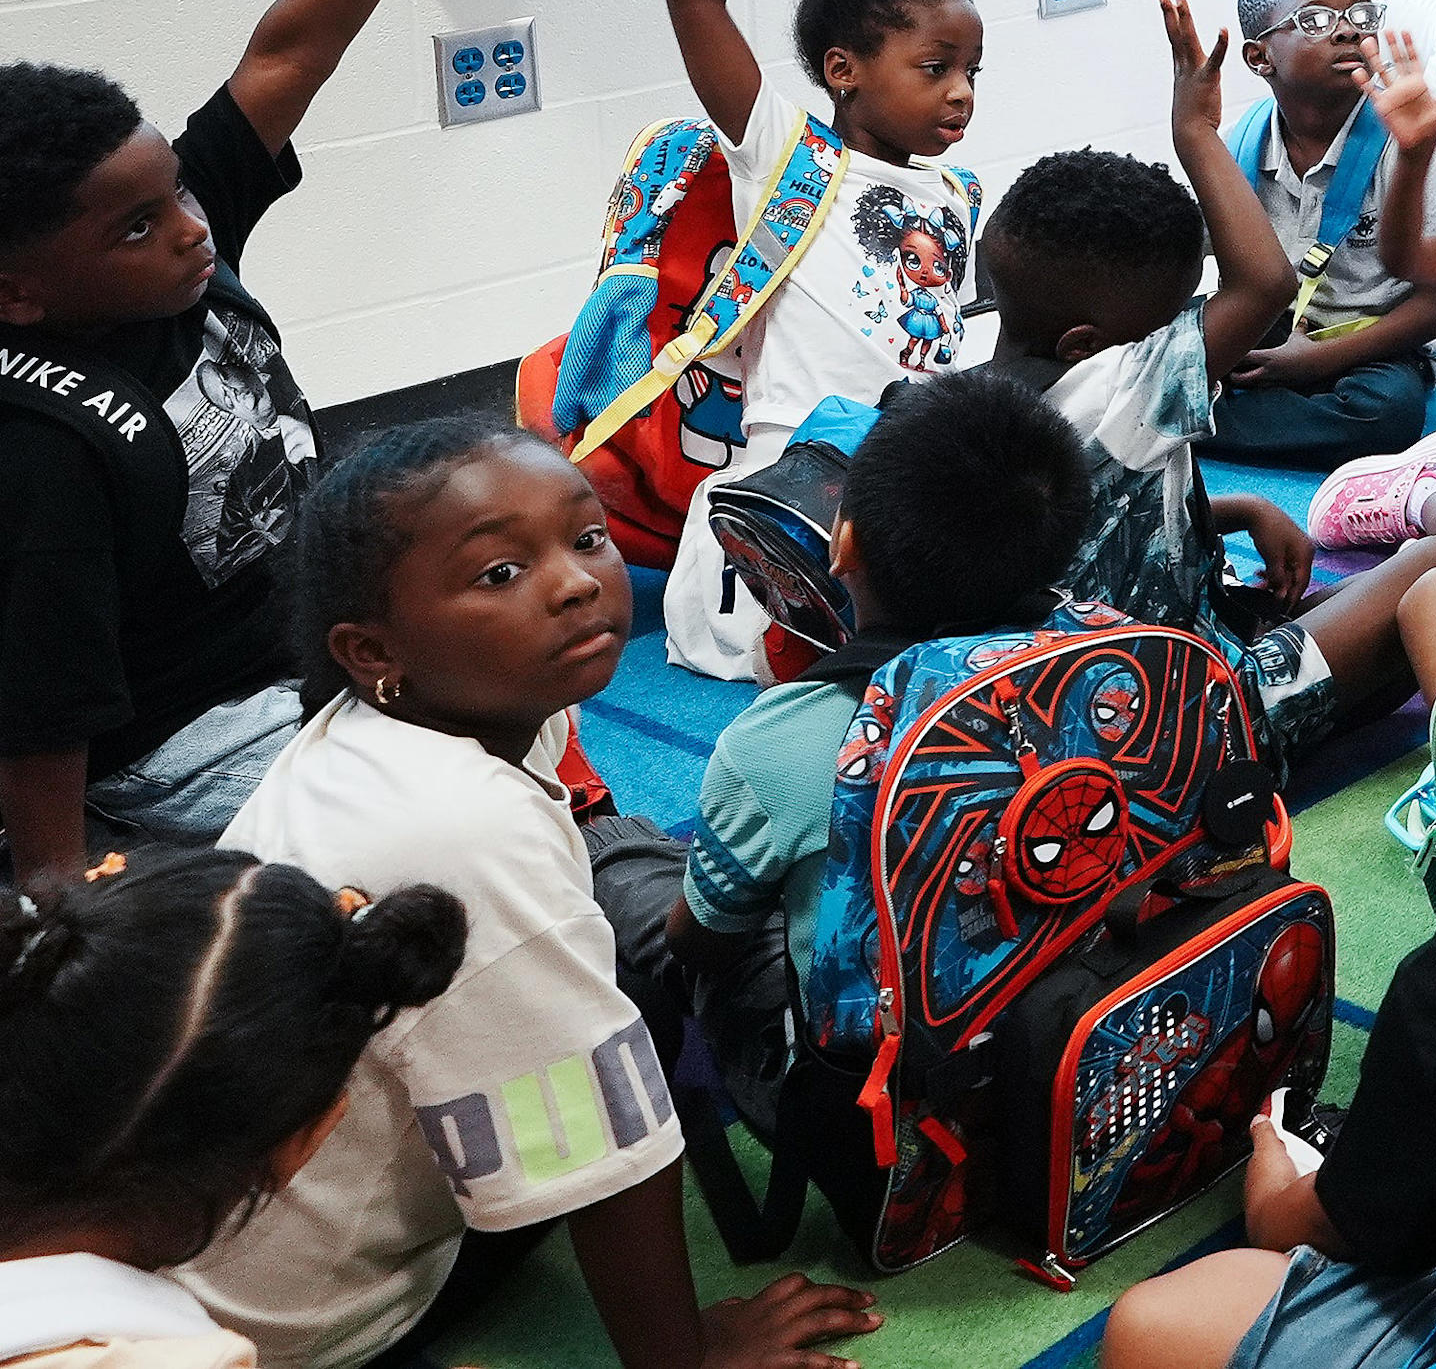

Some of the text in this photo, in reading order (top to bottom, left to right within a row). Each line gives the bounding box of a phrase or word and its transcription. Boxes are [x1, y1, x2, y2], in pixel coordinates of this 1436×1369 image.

[651, 139, 671, 176] KITTY
[789, 180, 823, 200] HELL
[0, 348, 147, 442] NIKE AIR
